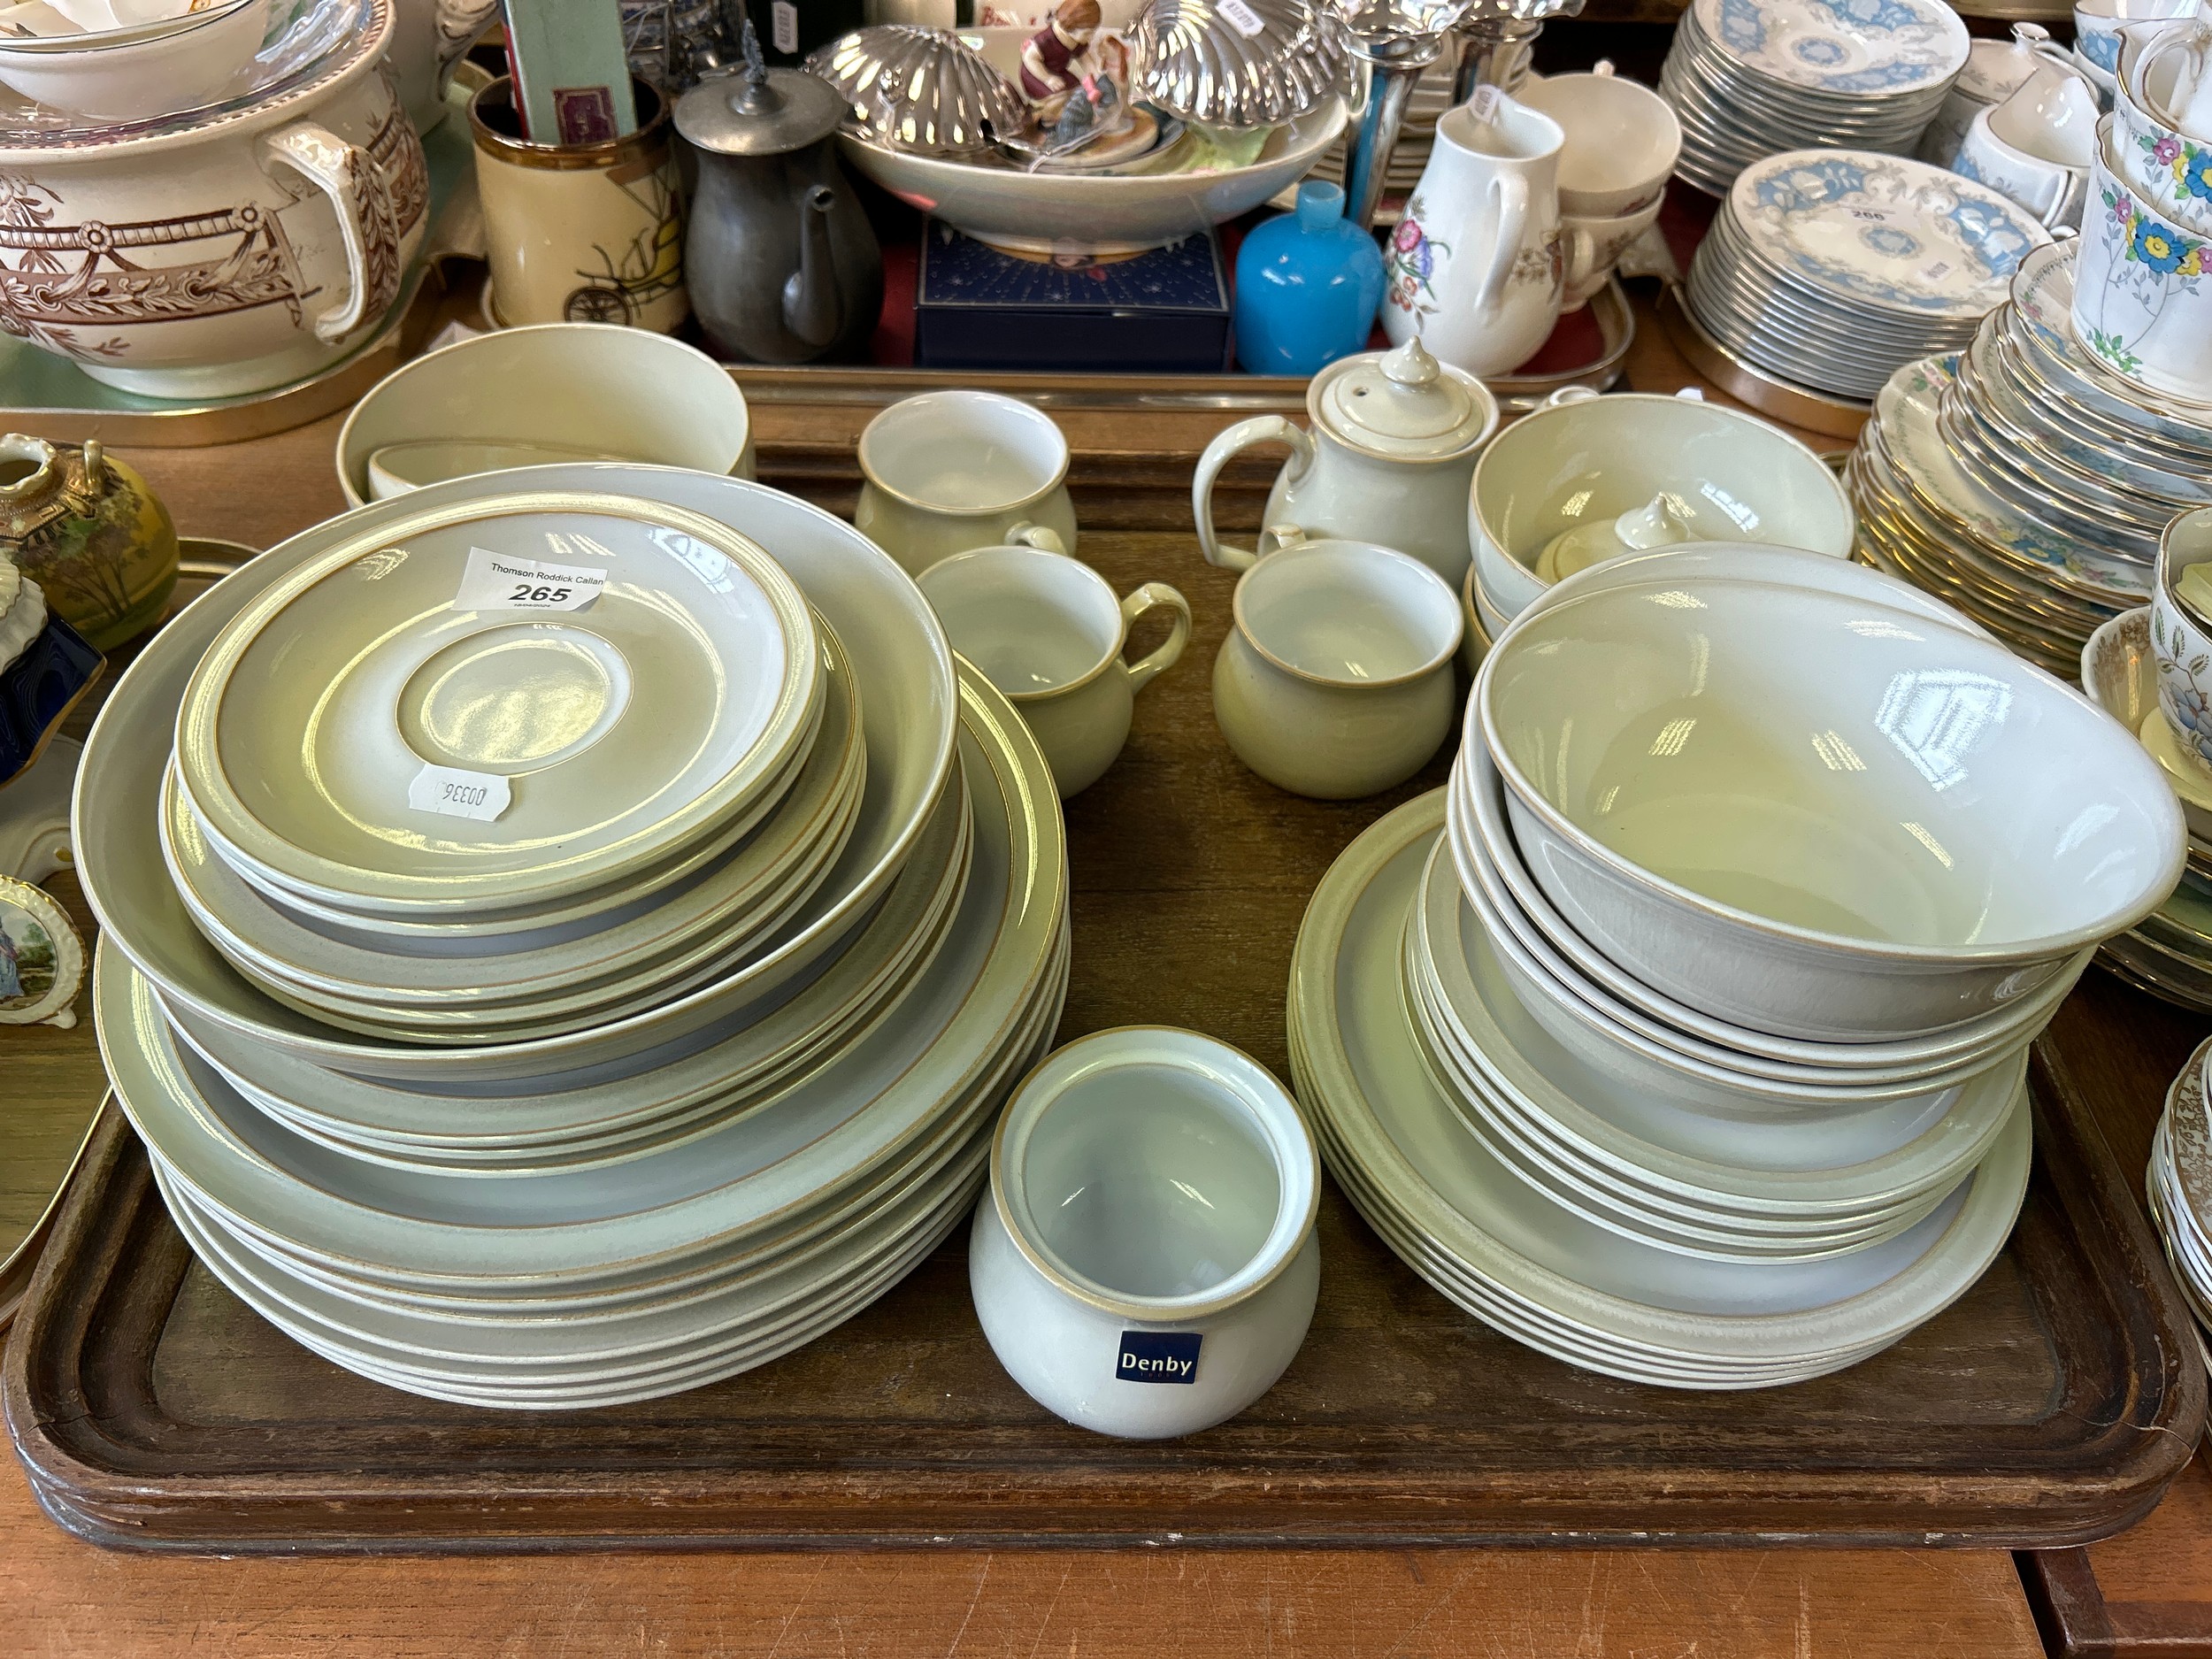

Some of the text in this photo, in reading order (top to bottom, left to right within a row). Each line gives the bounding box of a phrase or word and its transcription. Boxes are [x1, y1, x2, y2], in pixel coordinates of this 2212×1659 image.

[491, 563, 604, 586] Thomson Roddick Callan
[508, 584, 572, 603] 265
[1122, 1352, 1193, 1377] Denby
